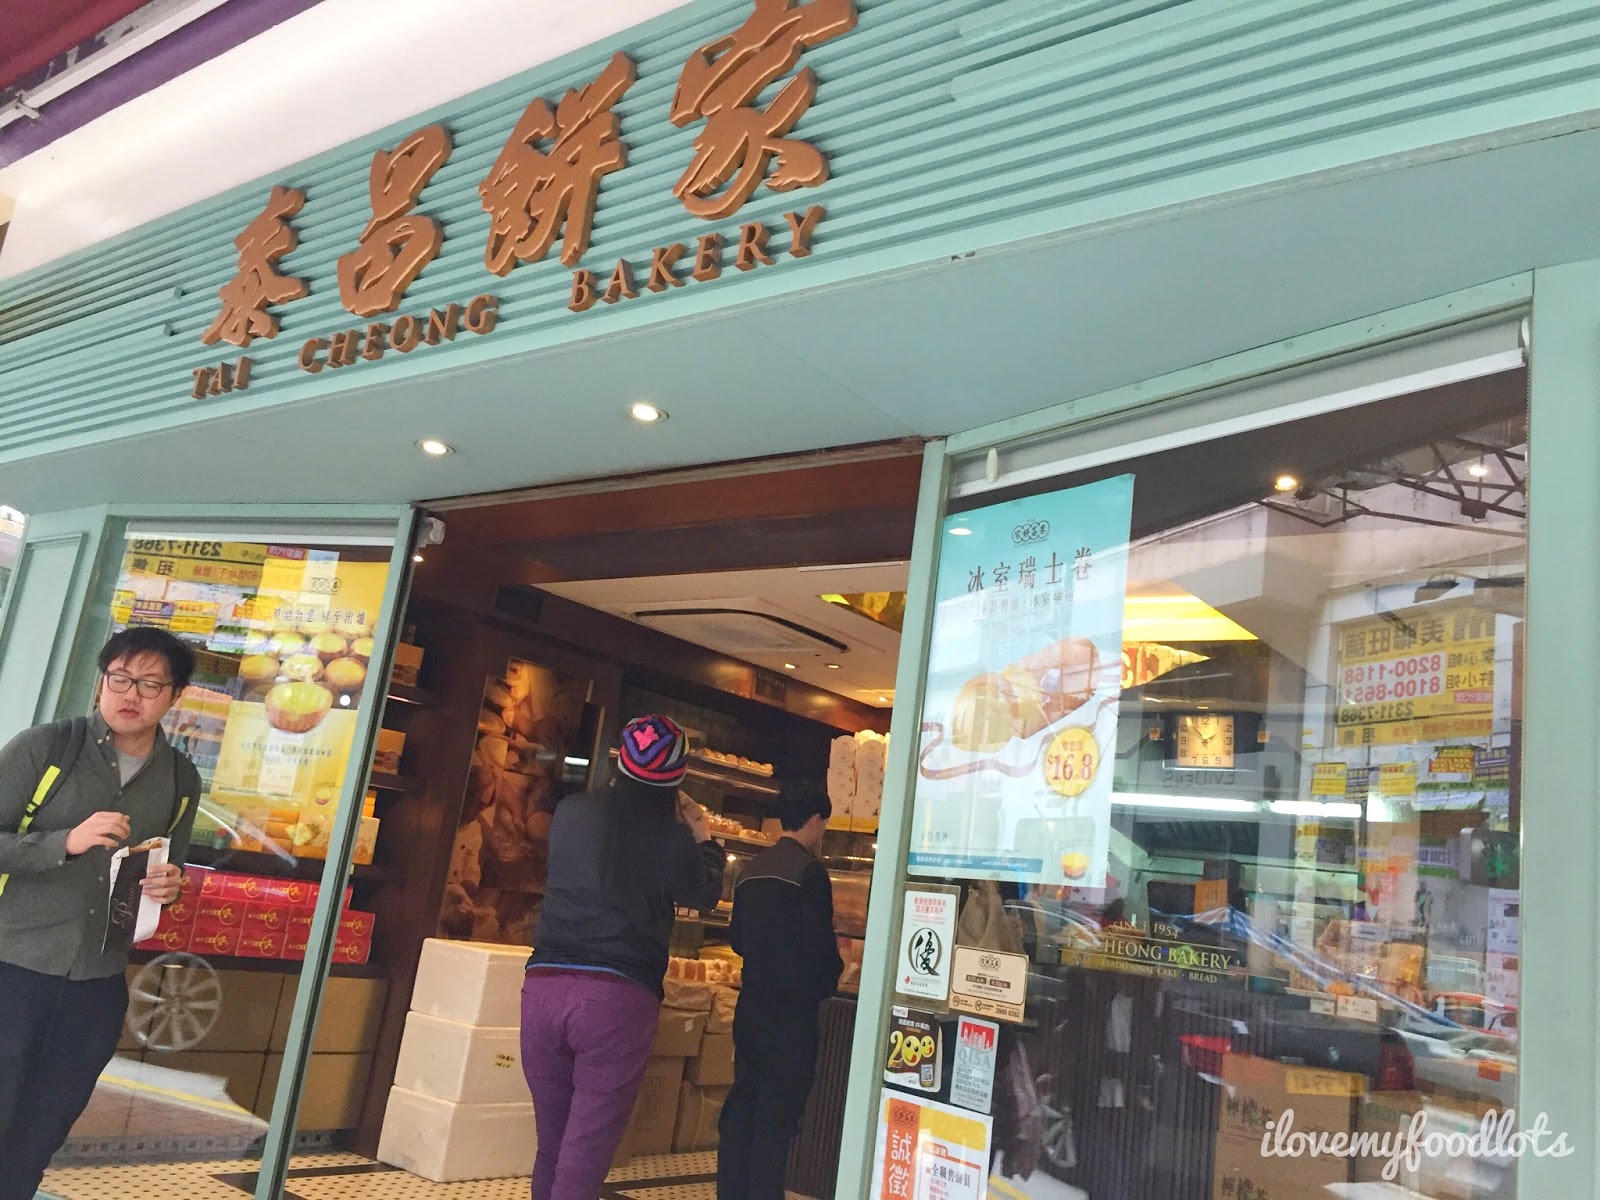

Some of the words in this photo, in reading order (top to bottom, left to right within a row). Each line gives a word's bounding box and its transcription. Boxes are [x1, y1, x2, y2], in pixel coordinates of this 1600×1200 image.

[192, 356, 253, 400] TAI
[300, 294, 499, 374] CHEONG
[567, 205, 827, 313] BAKERY
[967, 546, 1094, 594] 冰室瑞士卷
[1153, 922, 1180, 939] 1954
[1096, 938, 1163, 961] HEONG
[1168, 949, 1231, 970] BAKERY
[1189, 972, 1218, 983] BREAD
